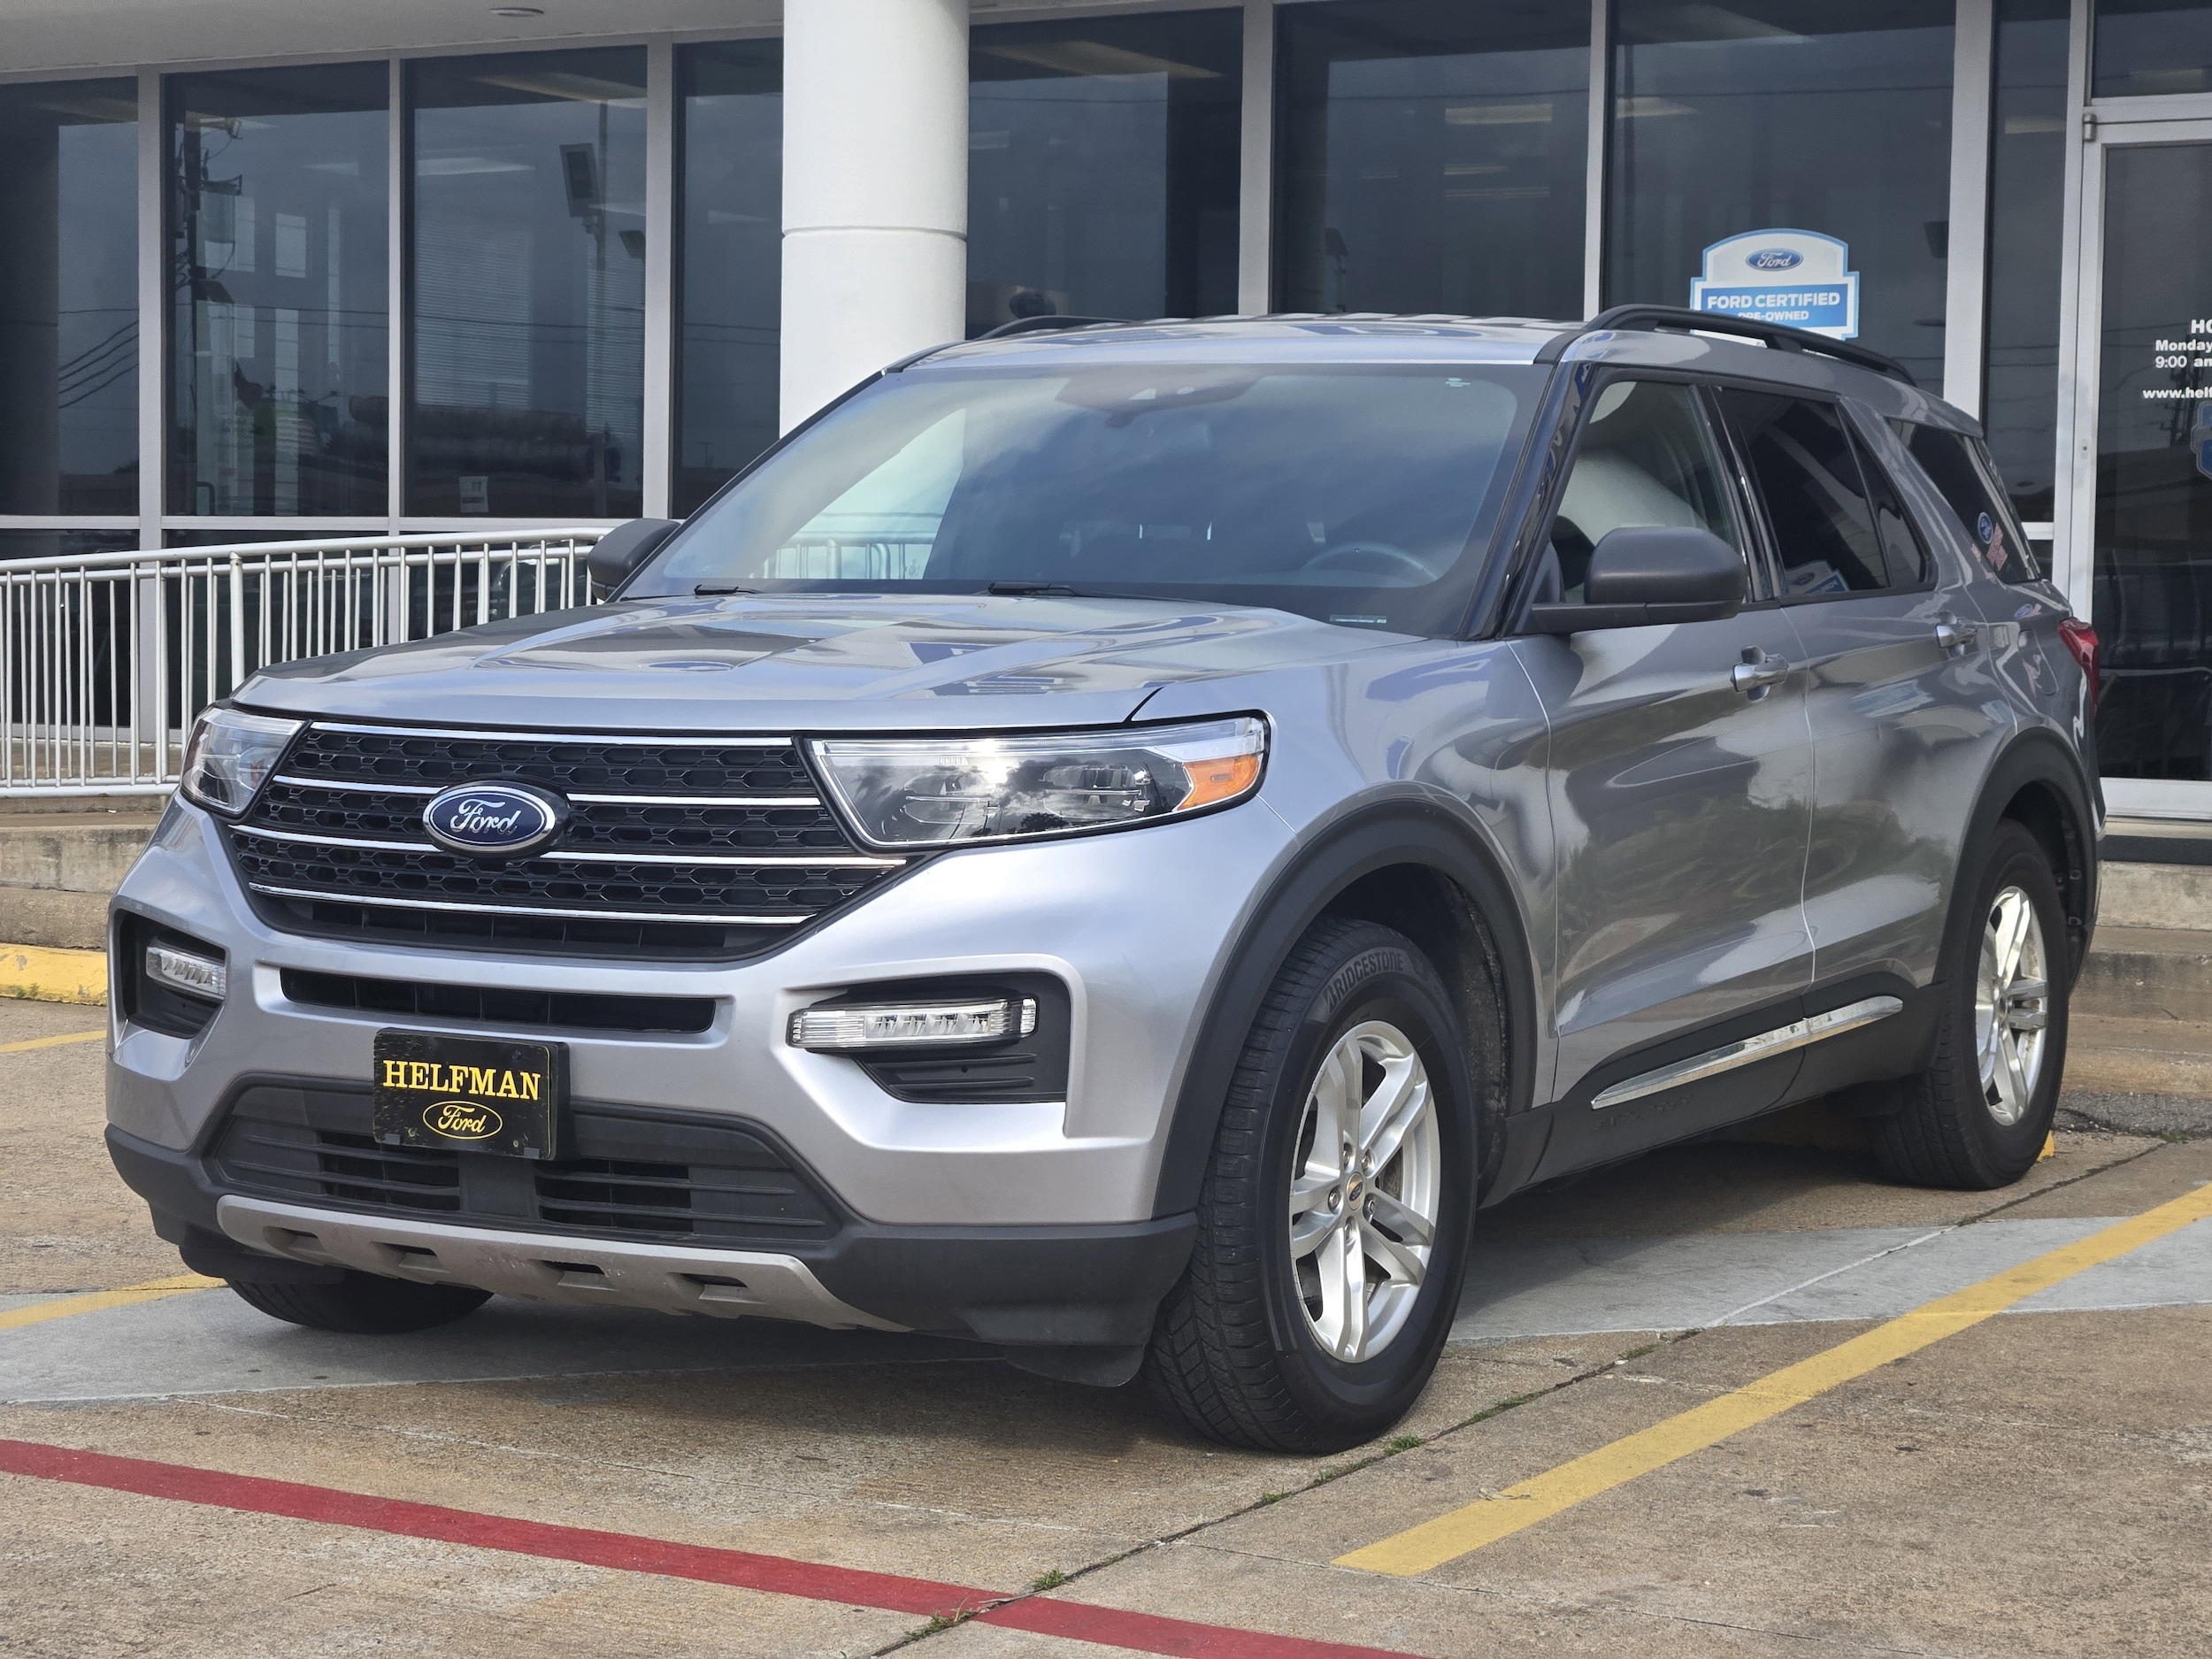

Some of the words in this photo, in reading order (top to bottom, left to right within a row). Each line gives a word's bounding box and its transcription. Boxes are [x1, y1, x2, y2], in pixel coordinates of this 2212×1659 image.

[1756, 251, 1792, 268] Ford
[1707, 295, 1753, 309] FORD
[1755, 292, 1840, 308] CERTIFIED
[2154, 355, 2187, 369] 9:00
[449, 798, 522, 835] Ford
[1324, 950, 1404, 1013] BRIDGESTONE
[382, 1059, 541, 1101] HELFMAN
[437, 1103, 488, 1133] Ford
